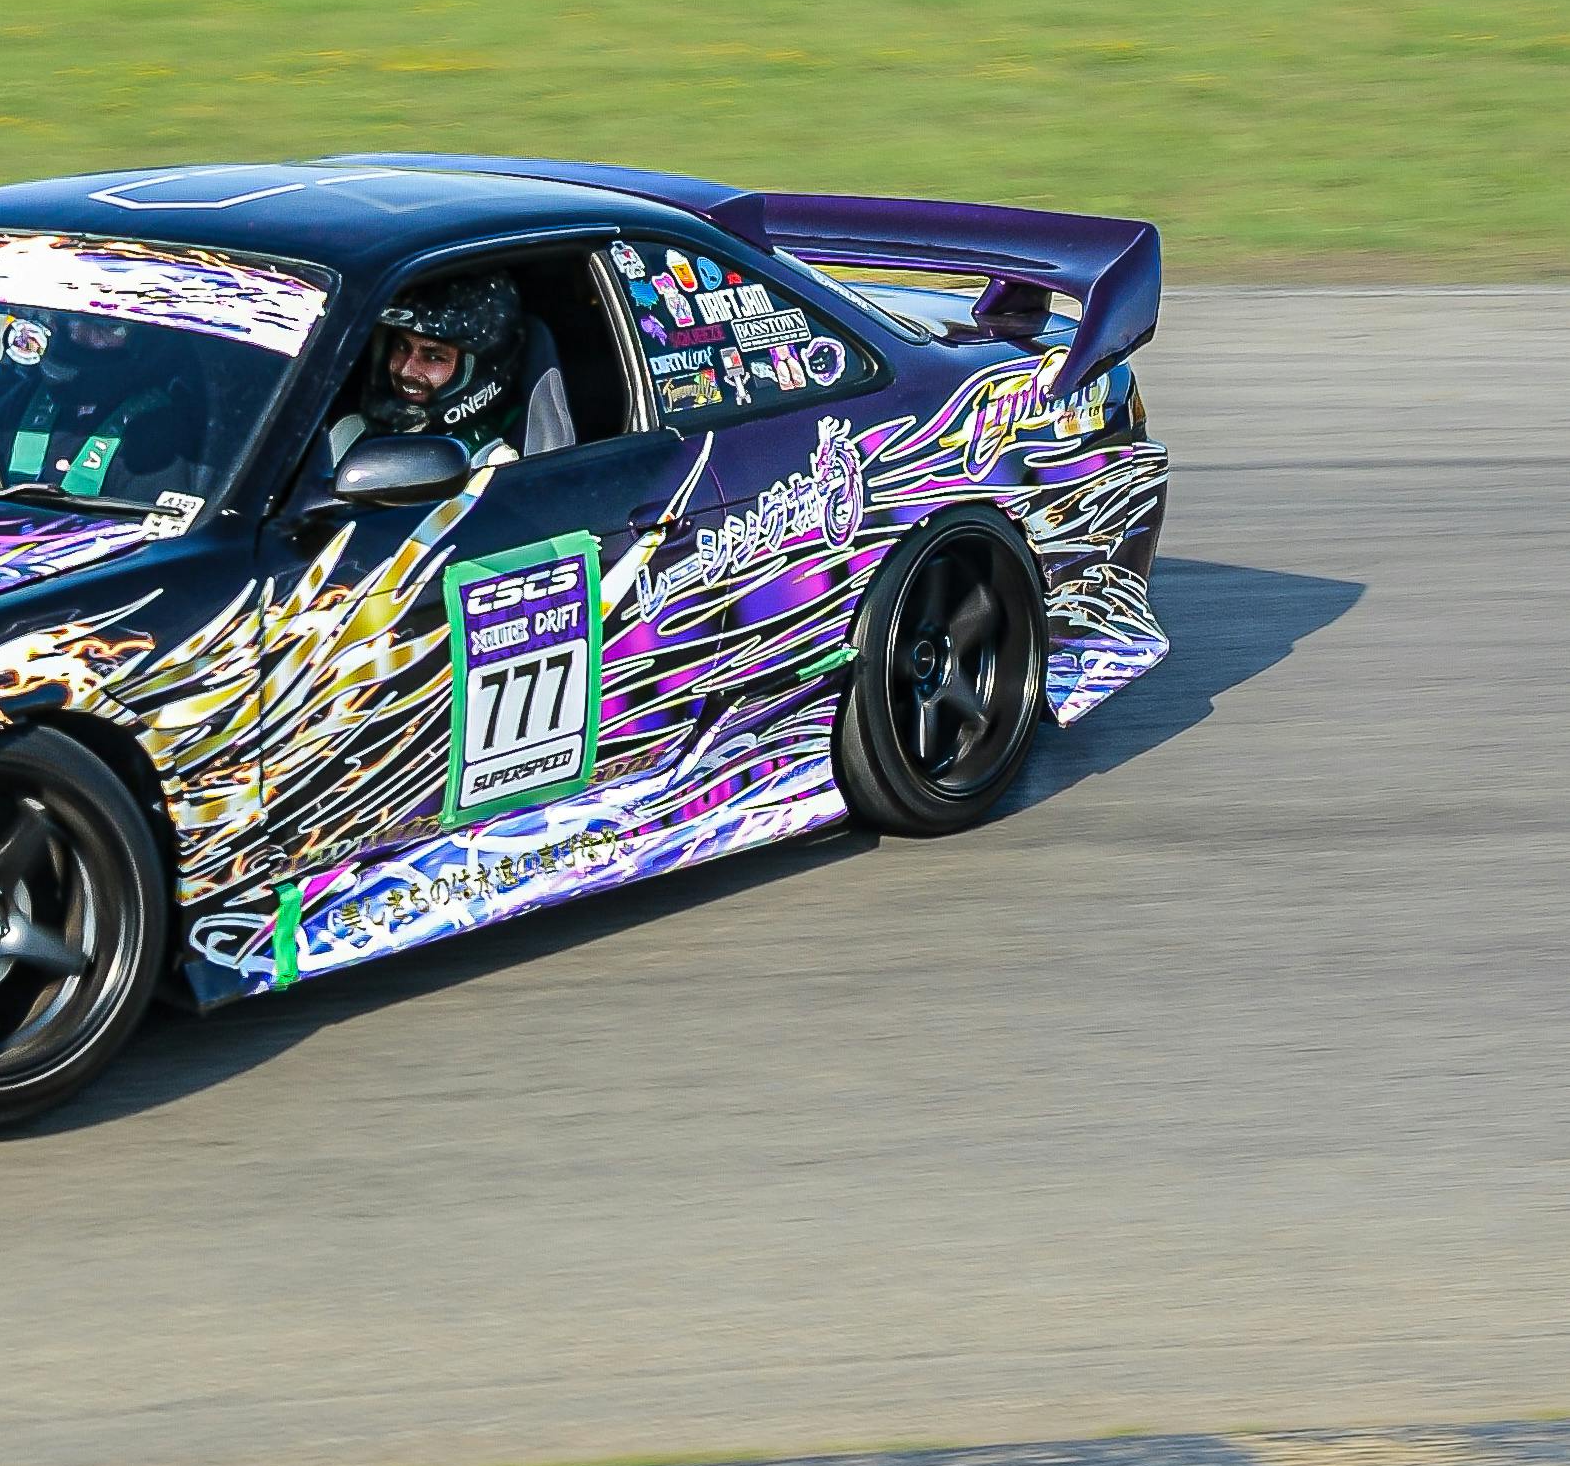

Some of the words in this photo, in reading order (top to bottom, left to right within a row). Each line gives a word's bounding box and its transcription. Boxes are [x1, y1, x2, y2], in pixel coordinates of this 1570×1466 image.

[695, 287, 742, 325] DRIFT
[736, 283, 775, 318] JAM
[466, 563, 581, 615] CSCS
[535, 601, 581, 636] DRIFT
[479, 650, 574, 751] 777
[470, 749, 574, 795] SUPERSPEED
